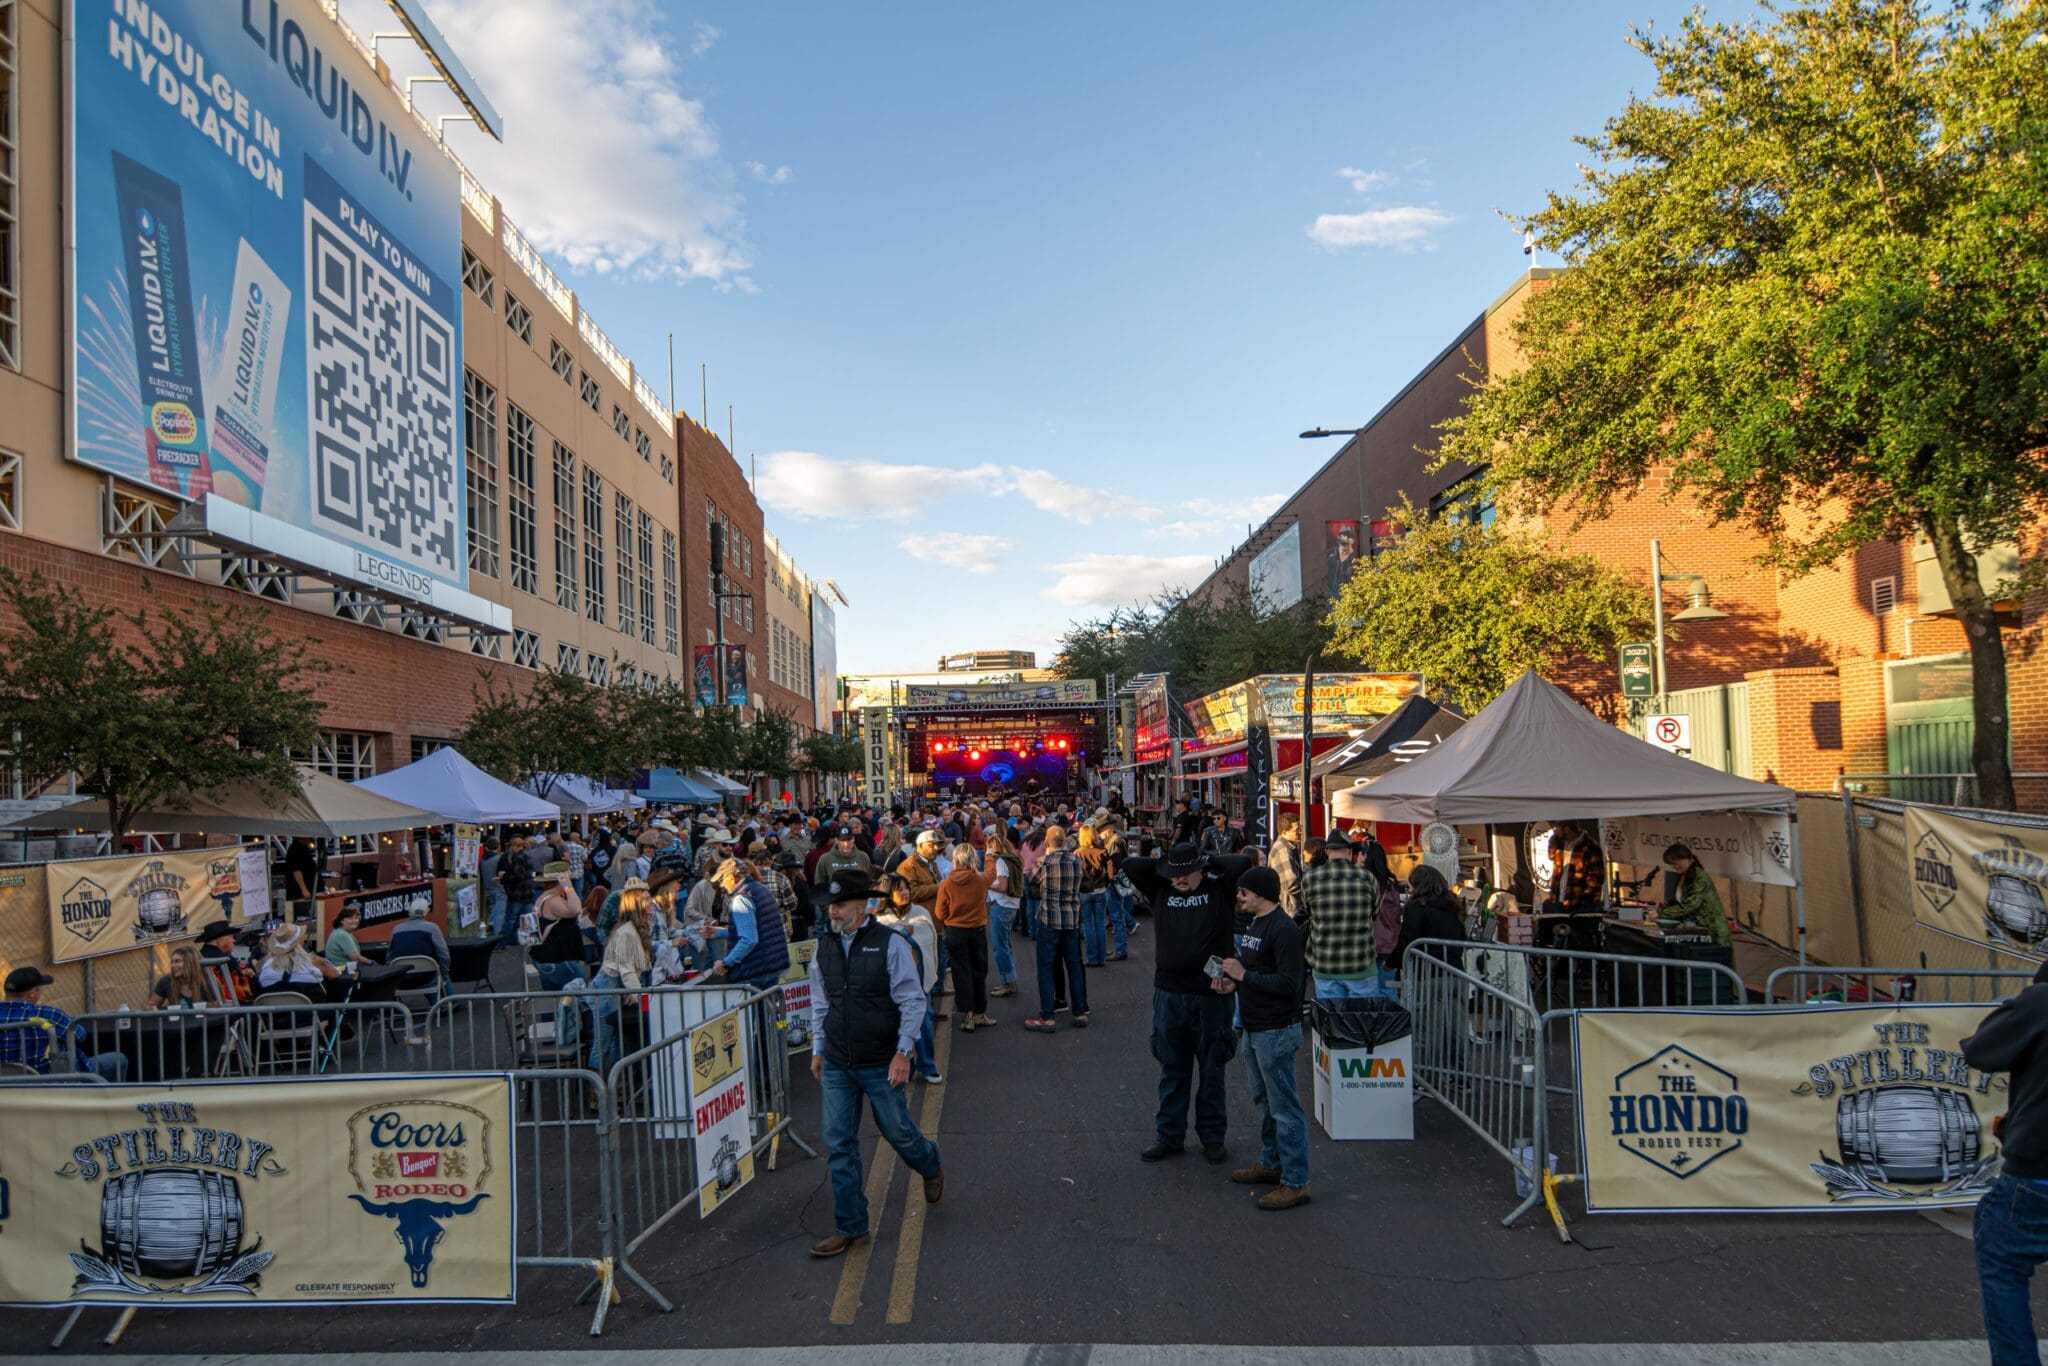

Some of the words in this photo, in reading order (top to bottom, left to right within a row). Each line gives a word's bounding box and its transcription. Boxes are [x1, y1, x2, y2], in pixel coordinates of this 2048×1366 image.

[242, 0, 373, 156] LIQUID
[109, 19, 283, 199] HYDRATION
[255, 109, 280, 160] IN
[340, 198, 379, 248] PLAY
[381, 236, 401, 269] TO
[403, 256, 431, 296] WIN
[158, 222, 176, 299] MULTIPLIER
[142, 272, 170, 373] LIQUID
[167, 299, 185, 377] HYDRATION
[234, 326, 257, 405] LIQUID
[148, 376, 194, 395] ELECTROLYTE
[155, 387, 176, 399] DRINK
[358, 553, 431, 595] LEGENDS
[79, 891, 94, 901] THE
[364, 895, 403, 920] BURGERS
[1167, 893, 1209, 908] SECURITY
[61, 899, 111, 925] HONDO
[1873, 1022, 1929, 1044] THE
[1338, 1057, 1406, 1078] WM
[1658, 1075, 1697, 1092] THE
[137, 1101, 197, 1123] THE
[696, 1080, 746, 1136] ENTRANCE
[1609, 1094, 1749, 1135] HONDO
[369, 1111, 466, 1148] Coors
[1638, 1137, 1681, 1148] RODEO
[1688, 1137, 1722, 1148] FEST
[72, 1126, 273, 1179] STILLERY
[402, 1155, 437, 1175] Banquet
[374, 1183, 467, 1199] RODEO
[295, 1283, 340, 1292] CELEBRATE
[342, 1282, 396, 1291] RESPONSIBLY
